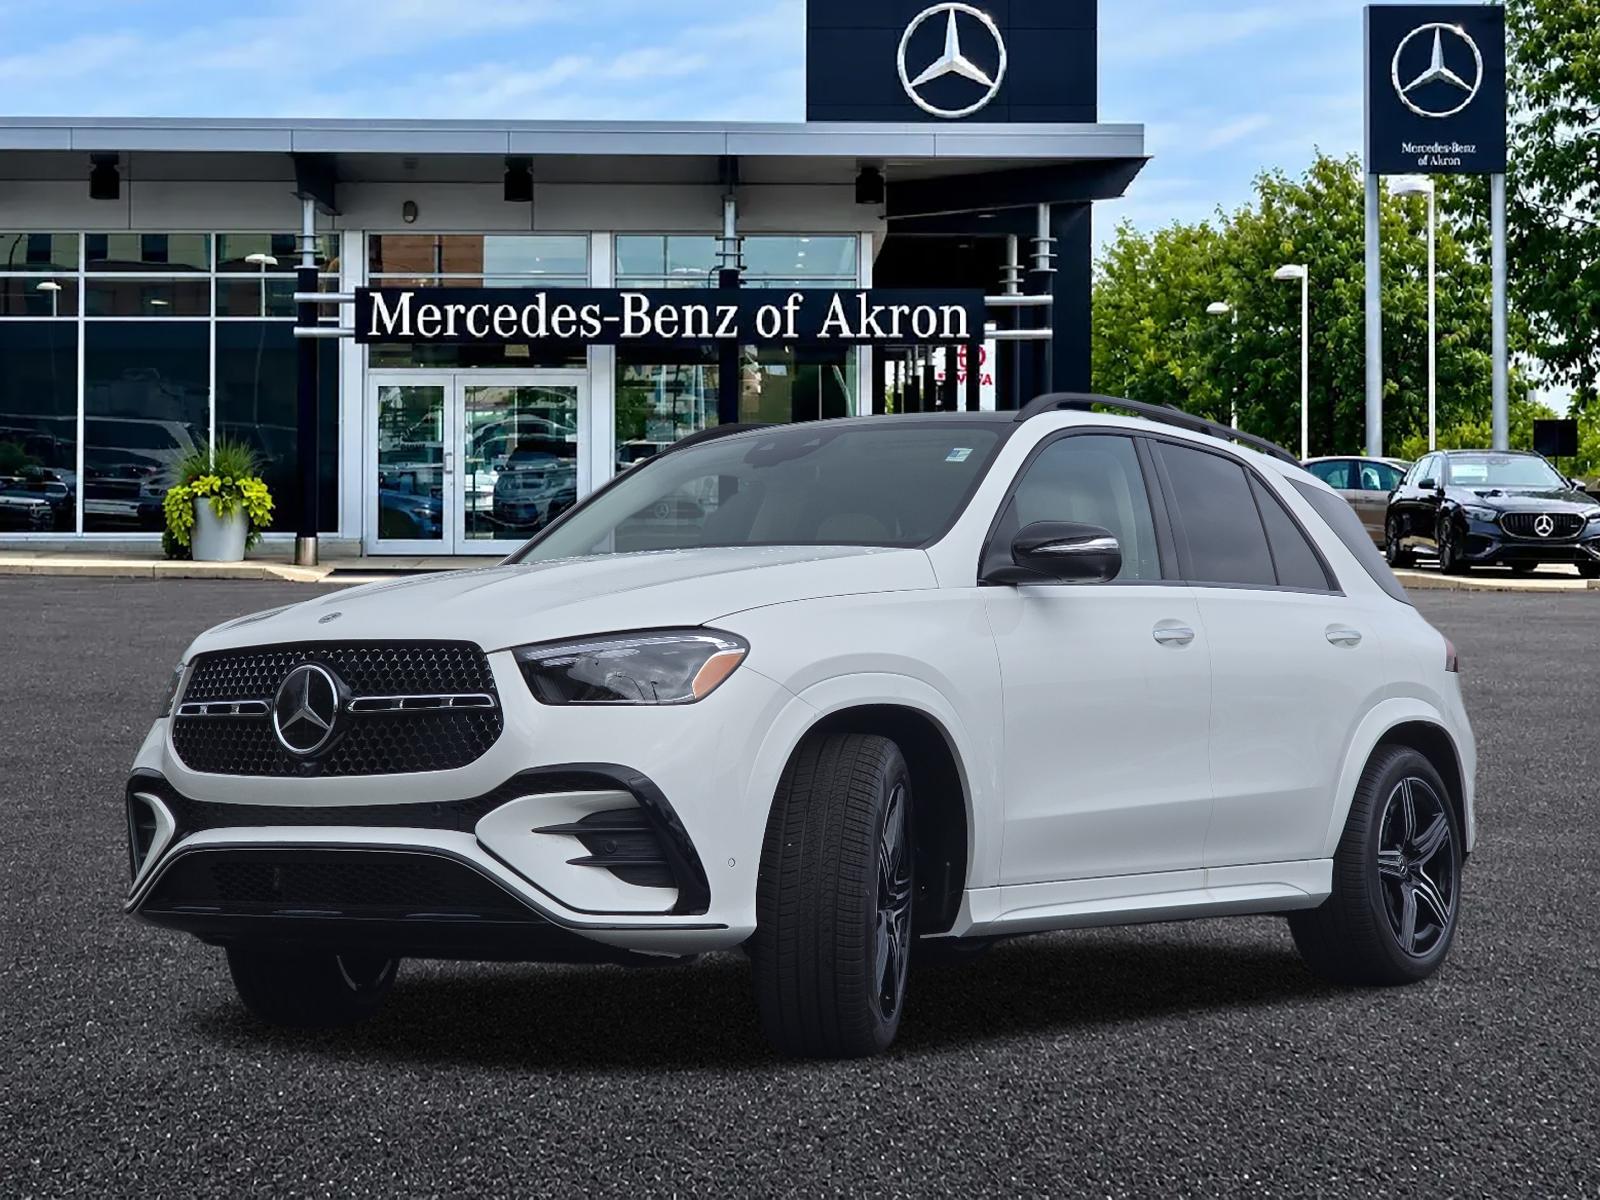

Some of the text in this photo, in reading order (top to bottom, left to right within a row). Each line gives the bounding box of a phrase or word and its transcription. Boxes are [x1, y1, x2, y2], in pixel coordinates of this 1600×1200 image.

[1401, 142, 1477, 154] Mercedes-Benz
[1417, 154, 1461, 166] of Akron
[367, 291, 971, 340] Mercedes-Benz of Akron
